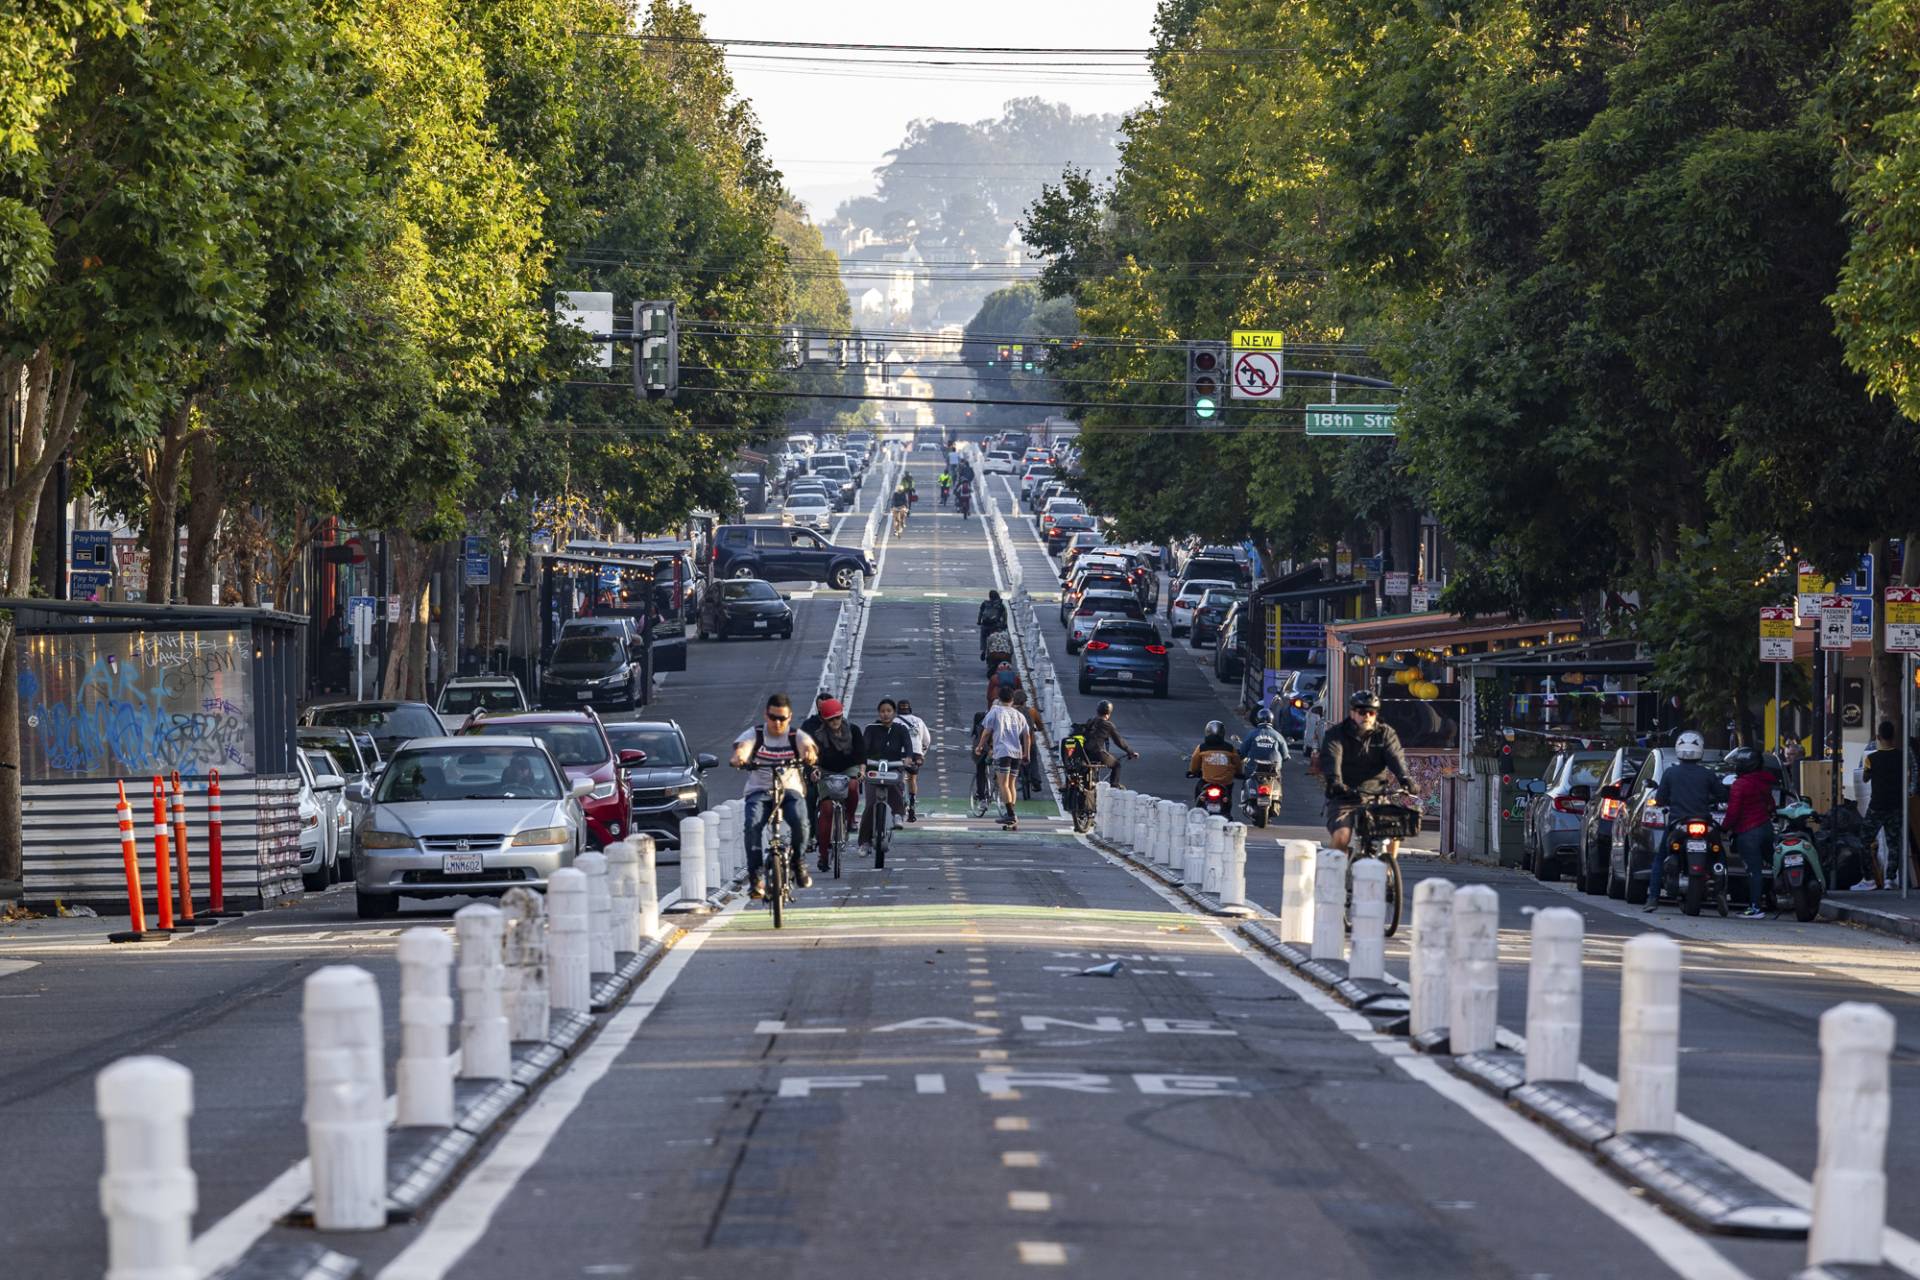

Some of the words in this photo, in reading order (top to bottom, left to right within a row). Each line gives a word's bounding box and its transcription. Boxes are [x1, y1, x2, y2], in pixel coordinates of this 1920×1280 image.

[1241, 335, 1273, 347] NEW
[1314, 413, 1353, 427] 18th
[74, 534, 88, 544] Pay
[90, 534, 108, 543] here
[73, 574, 87, 584] Pay
[88, 574, 98, 584] by
[754, 1016, 1239, 1036] LANE
[777, 1071, 1253, 1098] FIRE
